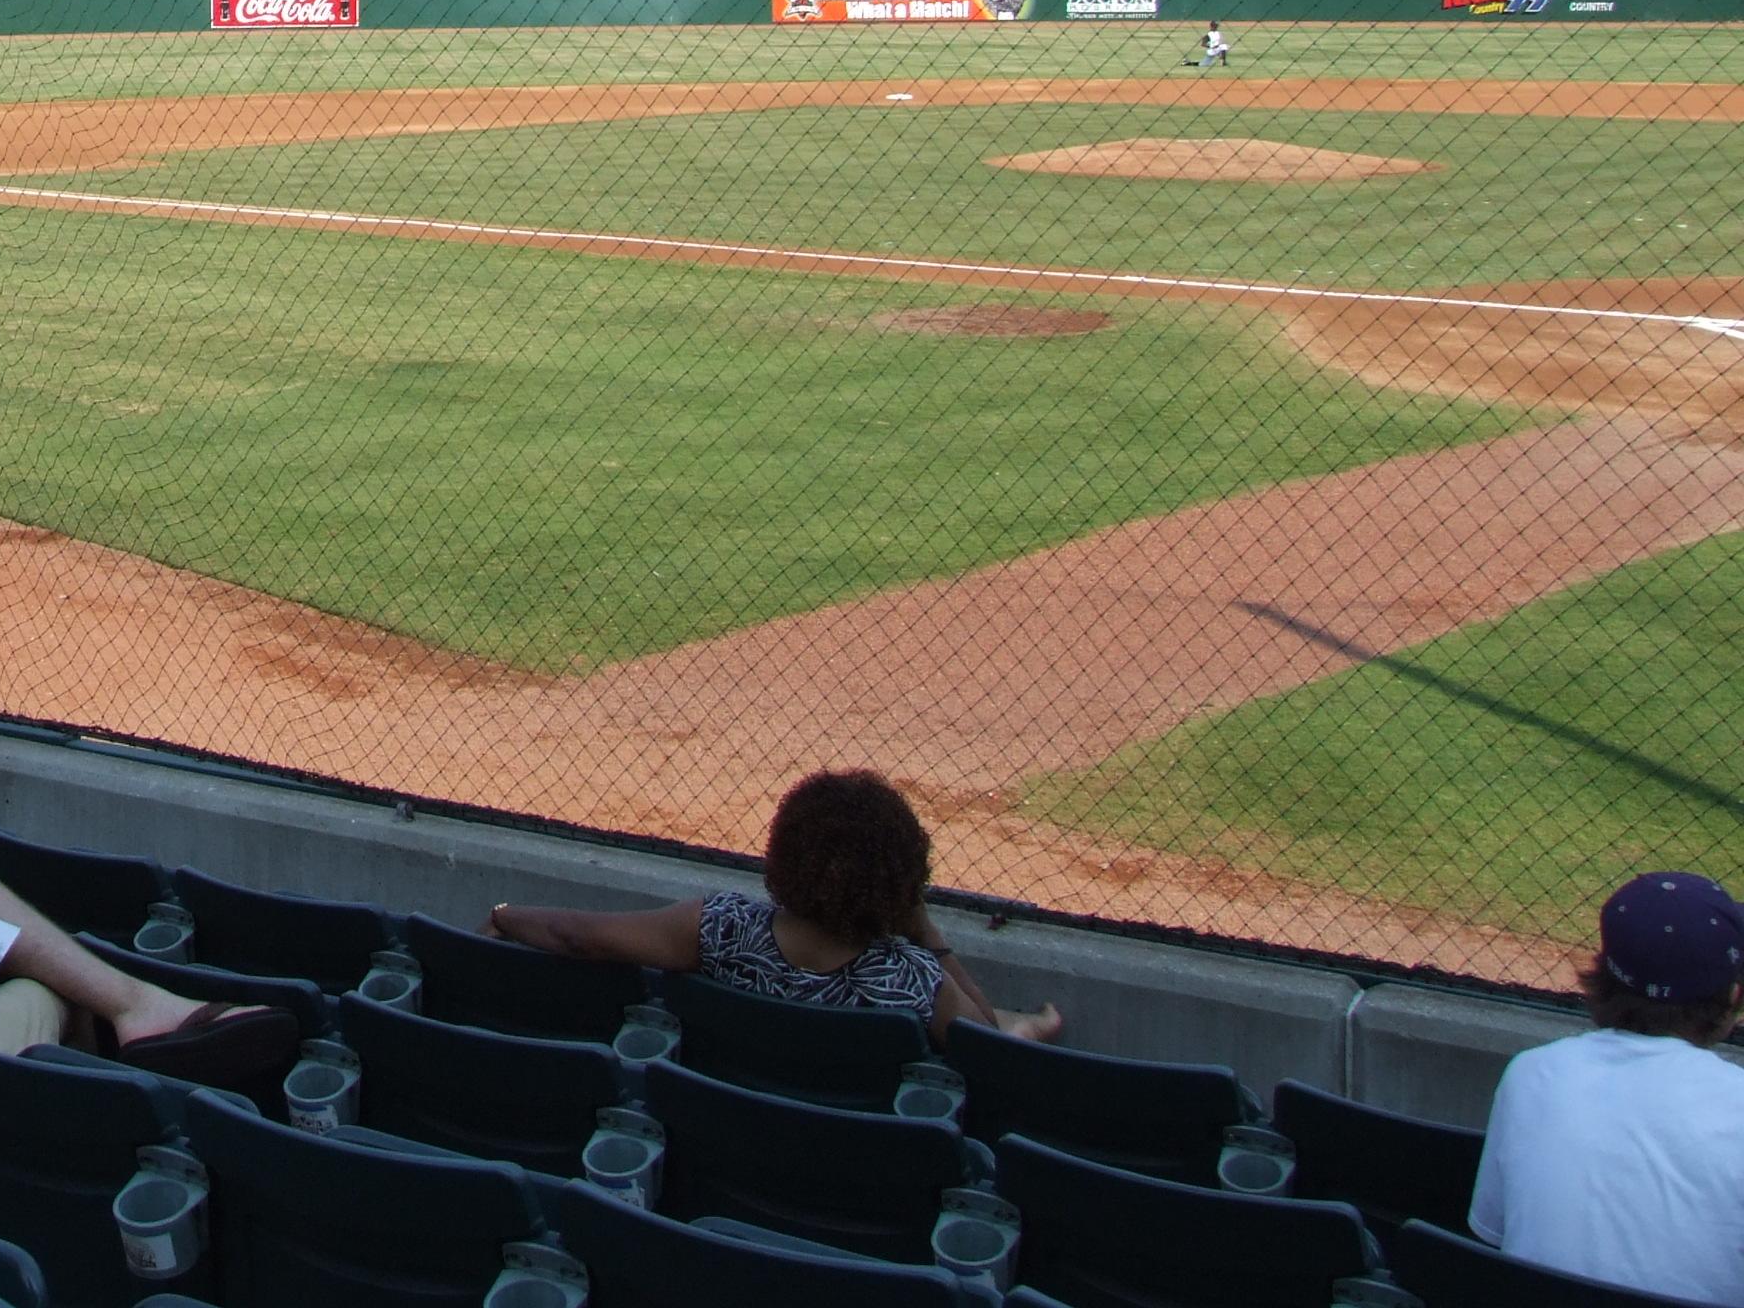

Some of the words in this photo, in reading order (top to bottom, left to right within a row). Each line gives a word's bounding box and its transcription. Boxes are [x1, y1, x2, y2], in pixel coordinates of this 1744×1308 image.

[846, 1, 893, 19] What
[894, 4, 907, 18] a
[1069, 4, 1153, 12] HOSPITAL
[1569, 1, 1615, 12] COUNTRY
